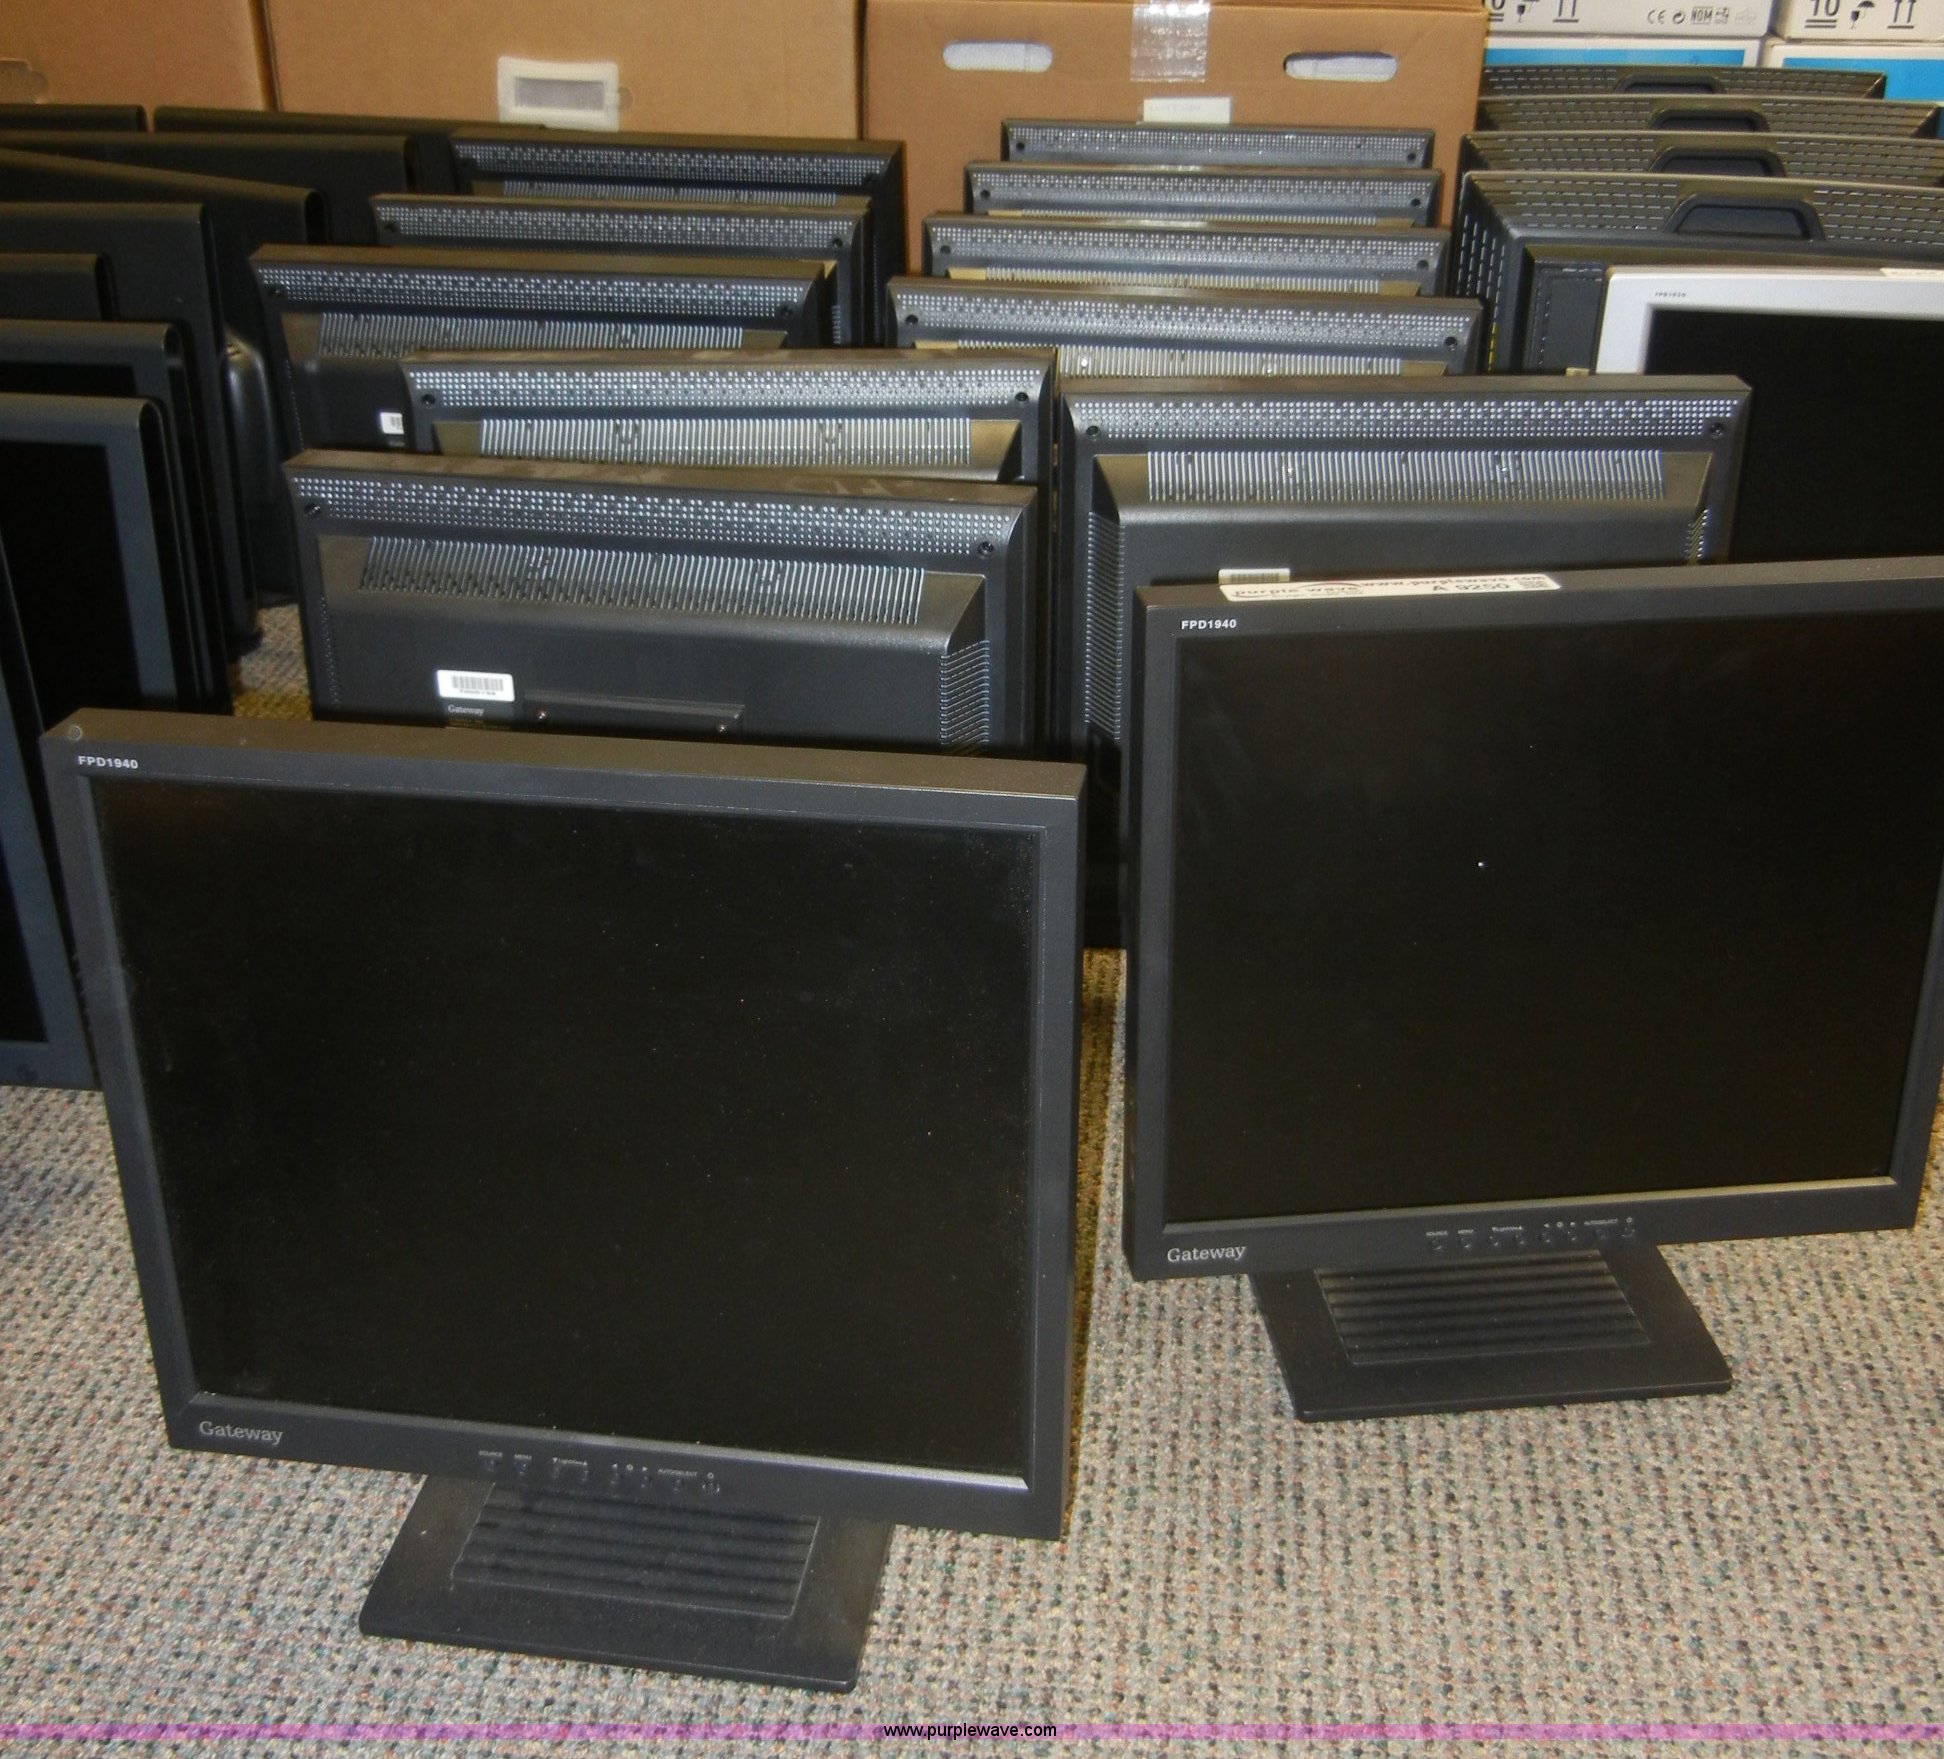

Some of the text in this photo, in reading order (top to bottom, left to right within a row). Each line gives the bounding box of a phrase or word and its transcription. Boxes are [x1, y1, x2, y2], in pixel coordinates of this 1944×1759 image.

[1181, 619, 1237, 630] FPD1940
[447, 704, 485, 717] Gateway
[78, 755, 139, 769] FPD1940
[1166, 1246, 1247, 1263] Gateway
[199, 1421, 284, 1446] Gateway
